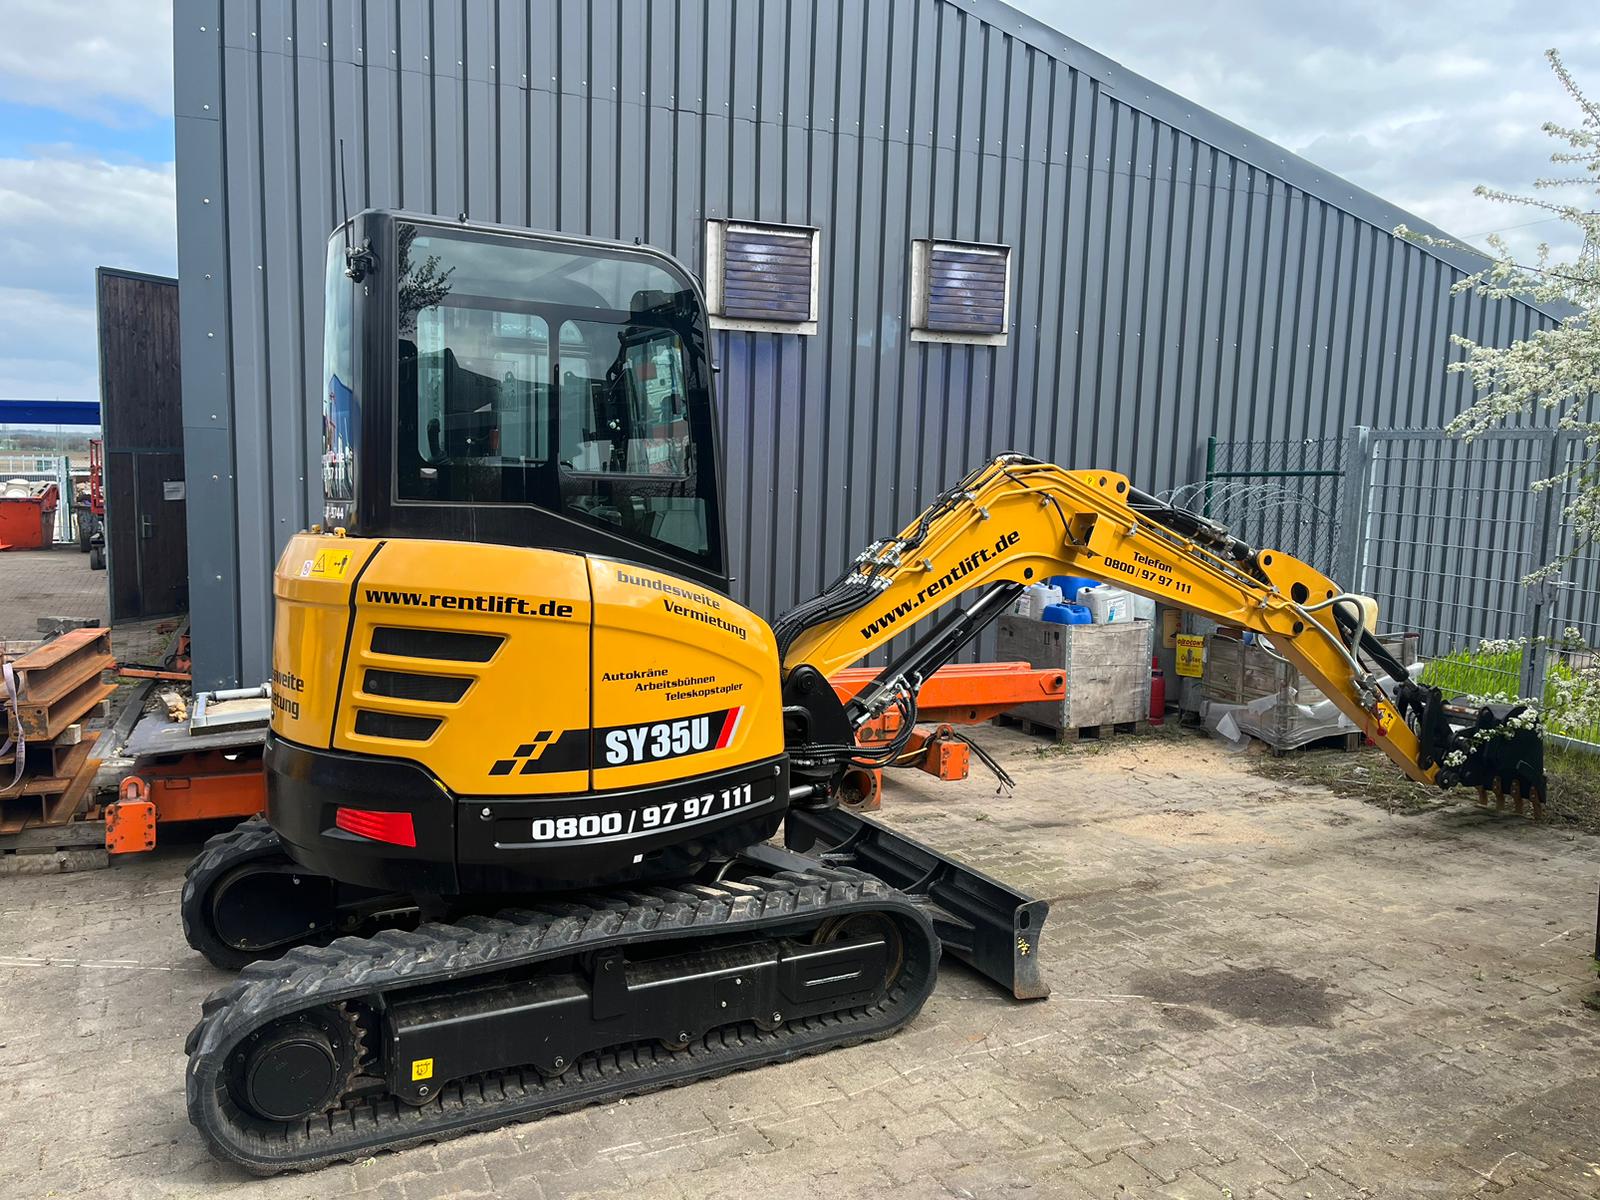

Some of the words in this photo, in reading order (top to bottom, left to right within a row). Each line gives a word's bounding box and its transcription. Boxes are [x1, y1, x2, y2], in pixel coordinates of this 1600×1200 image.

[1104, 556, 1135, 575] 0800
[1141, 569, 1157, 582] 97
[1157, 575, 1173, 587] 97
[1175, 581, 1192, 594] 111
[1134, 551, 1173, 573] Telefon
[617, 570, 721, 610] bundesweite
[860, 530, 1021, 640] www.rentlift.de
[365, 589, 573, 618] www.rentlift.de
[663, 599, 747, 641] Vermietung
[601, 668, 669, 682] Autokräne
[634, 675, 716, 692] Arbeitsbühnen
[665, 682, 744, 701] Teleskopstapler
[532, 812, 622, 840] 0800
[642, 802, 678, 828] 97
[683, 793, 715, 820] 97
[721, 784, 752, 810] 111
